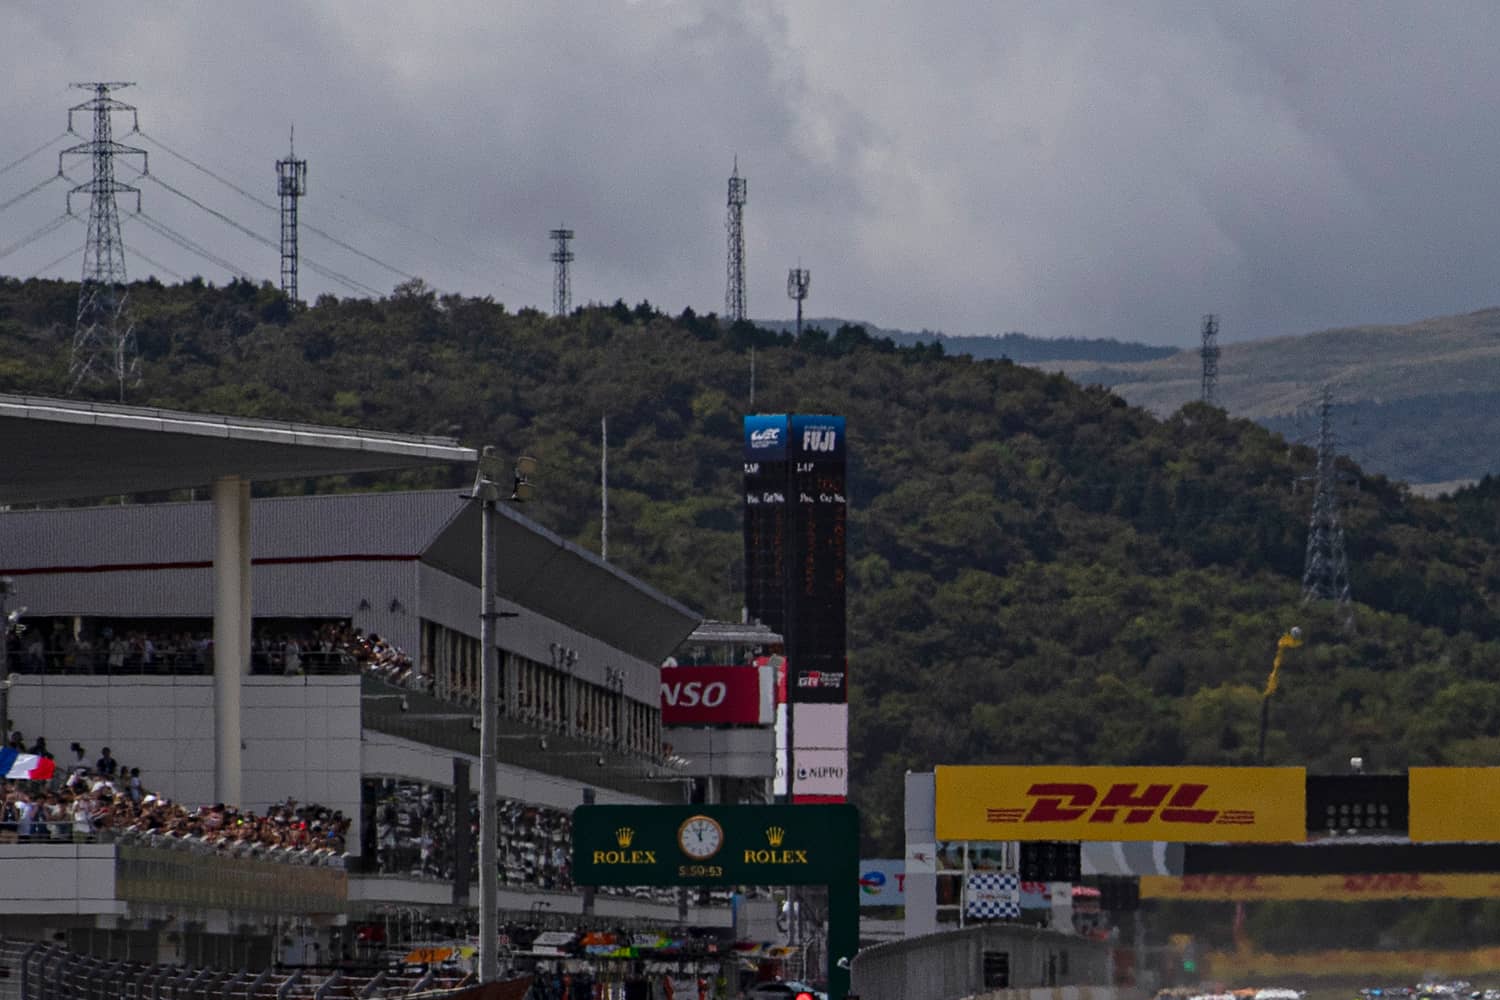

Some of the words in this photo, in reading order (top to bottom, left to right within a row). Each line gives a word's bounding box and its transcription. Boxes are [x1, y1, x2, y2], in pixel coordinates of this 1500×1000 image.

[803, 431, 836, 451] FUJI
[809, 766, 843, 778] NIPPO
[1023, 783, 1220, 824] DHL
[593, 850, 657, 865] ROLEX
[743, 849, 808, 864] ROLEX
